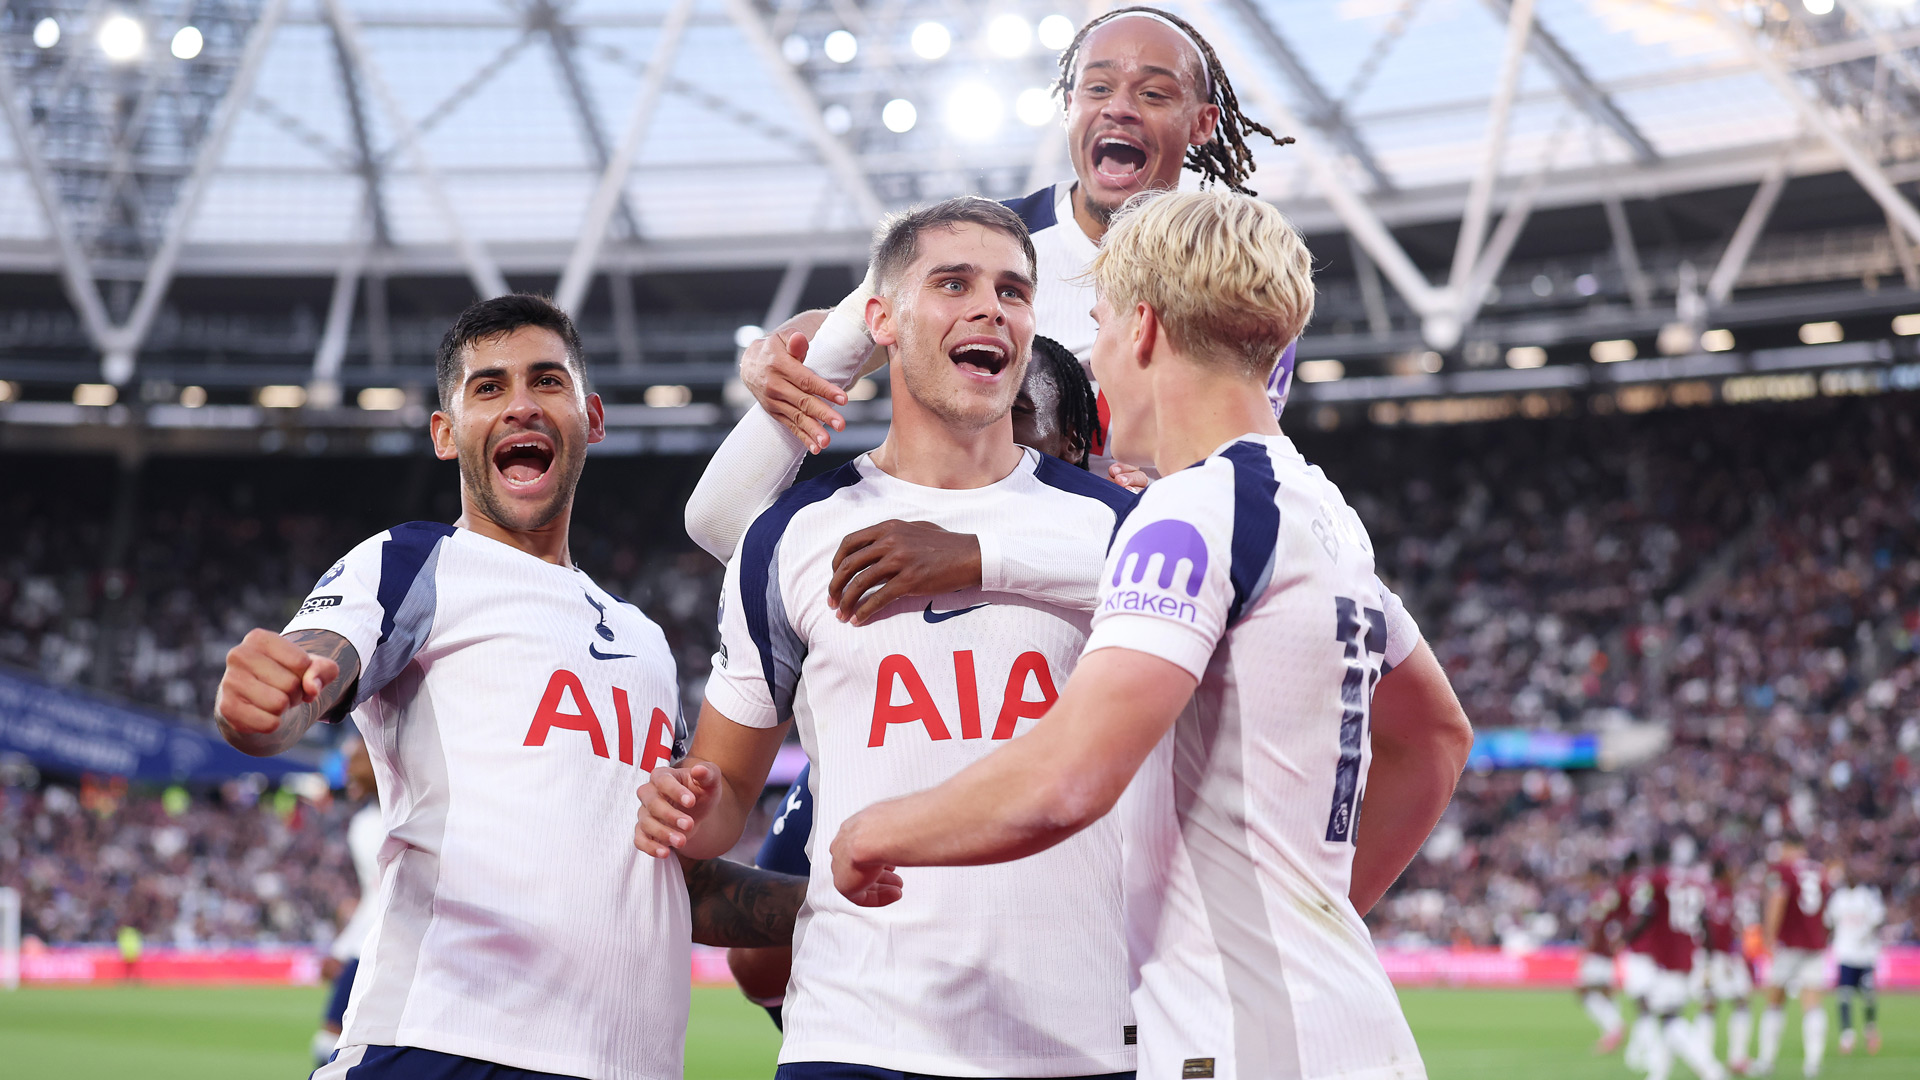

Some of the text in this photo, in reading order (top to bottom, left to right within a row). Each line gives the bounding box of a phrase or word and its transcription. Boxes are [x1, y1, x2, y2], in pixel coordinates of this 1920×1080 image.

[1105, 591, 1197, 622] kraken
[523, 669, 675, 773] AIA
[867, 650, 1060, 748] AIA
